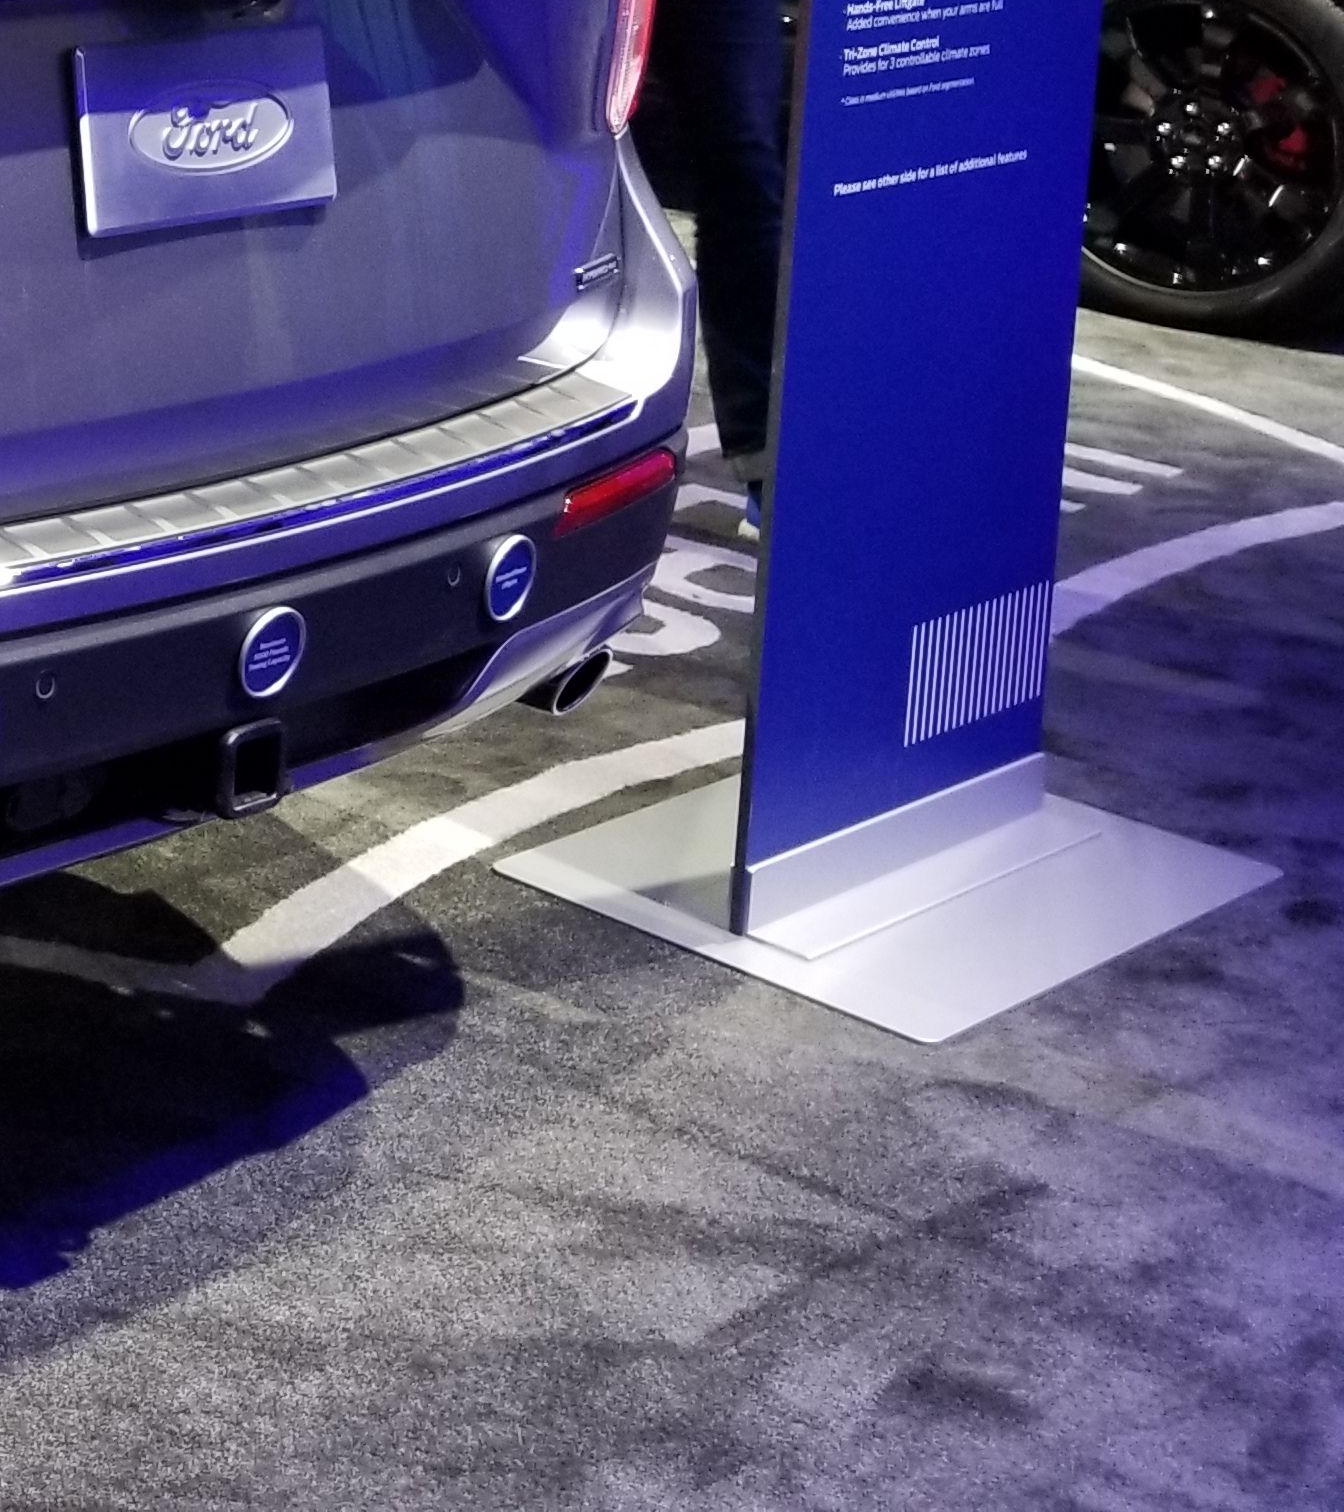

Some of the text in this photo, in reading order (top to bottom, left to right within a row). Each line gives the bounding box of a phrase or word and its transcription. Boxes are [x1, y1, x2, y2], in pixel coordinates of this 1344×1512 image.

[846, 0, 894, 17] Hands-Free
[843, 35, 940, 62] Tri-Zone Climate Control
[161, 96, 261, 162] Ford
[833, 181, 862, 197] Please
[861, 178, 877, 191] see
[877, 174, 900, 188] other
[899, 170, 916, 184] side
[916, 167, 929, 181] for
[935, 163, 948, 176] list
[948, 159, 960, 174] of
[958, 153, 997, 172] additional
[997, 149, 1028, 165] features
